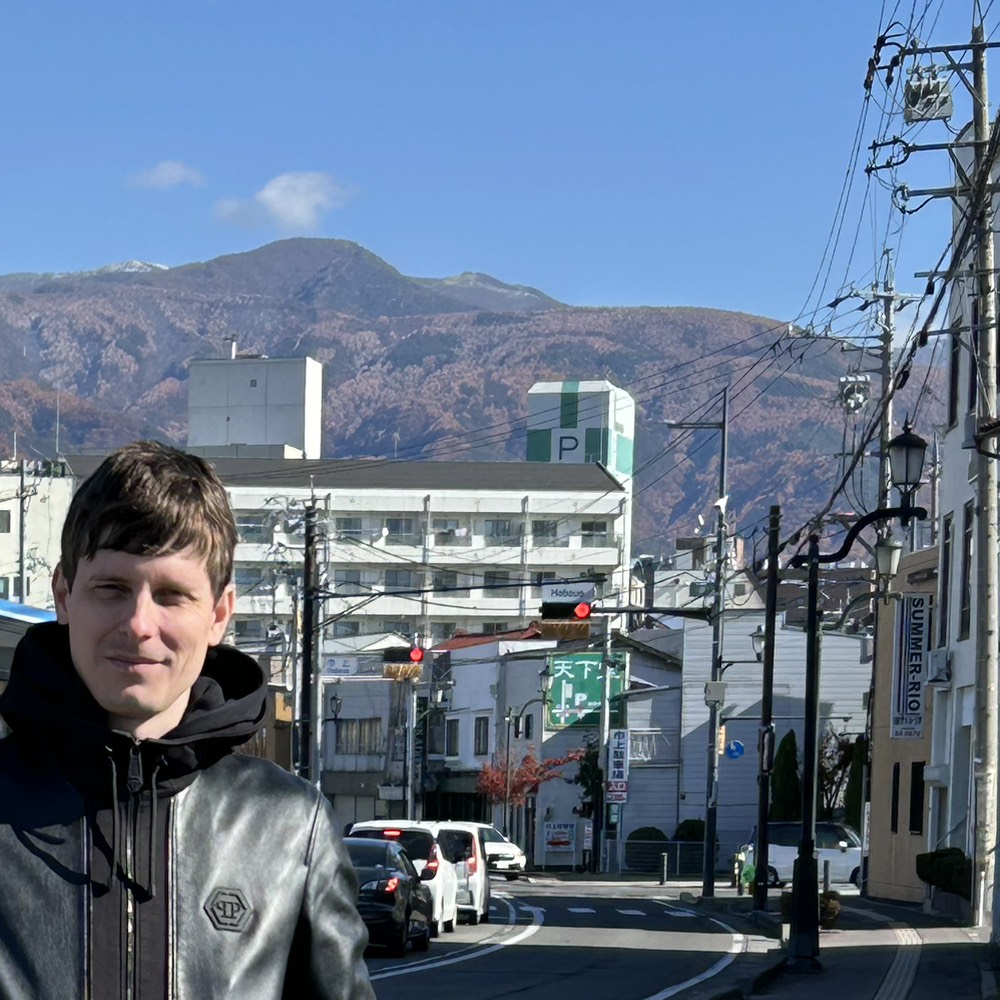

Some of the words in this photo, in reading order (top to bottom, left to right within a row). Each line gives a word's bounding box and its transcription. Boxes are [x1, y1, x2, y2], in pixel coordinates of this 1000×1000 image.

[559, 436, 579, 460] P
[907, 597, 925, 712] SUMMER-RIO
[574, 693, 588, 706] P
